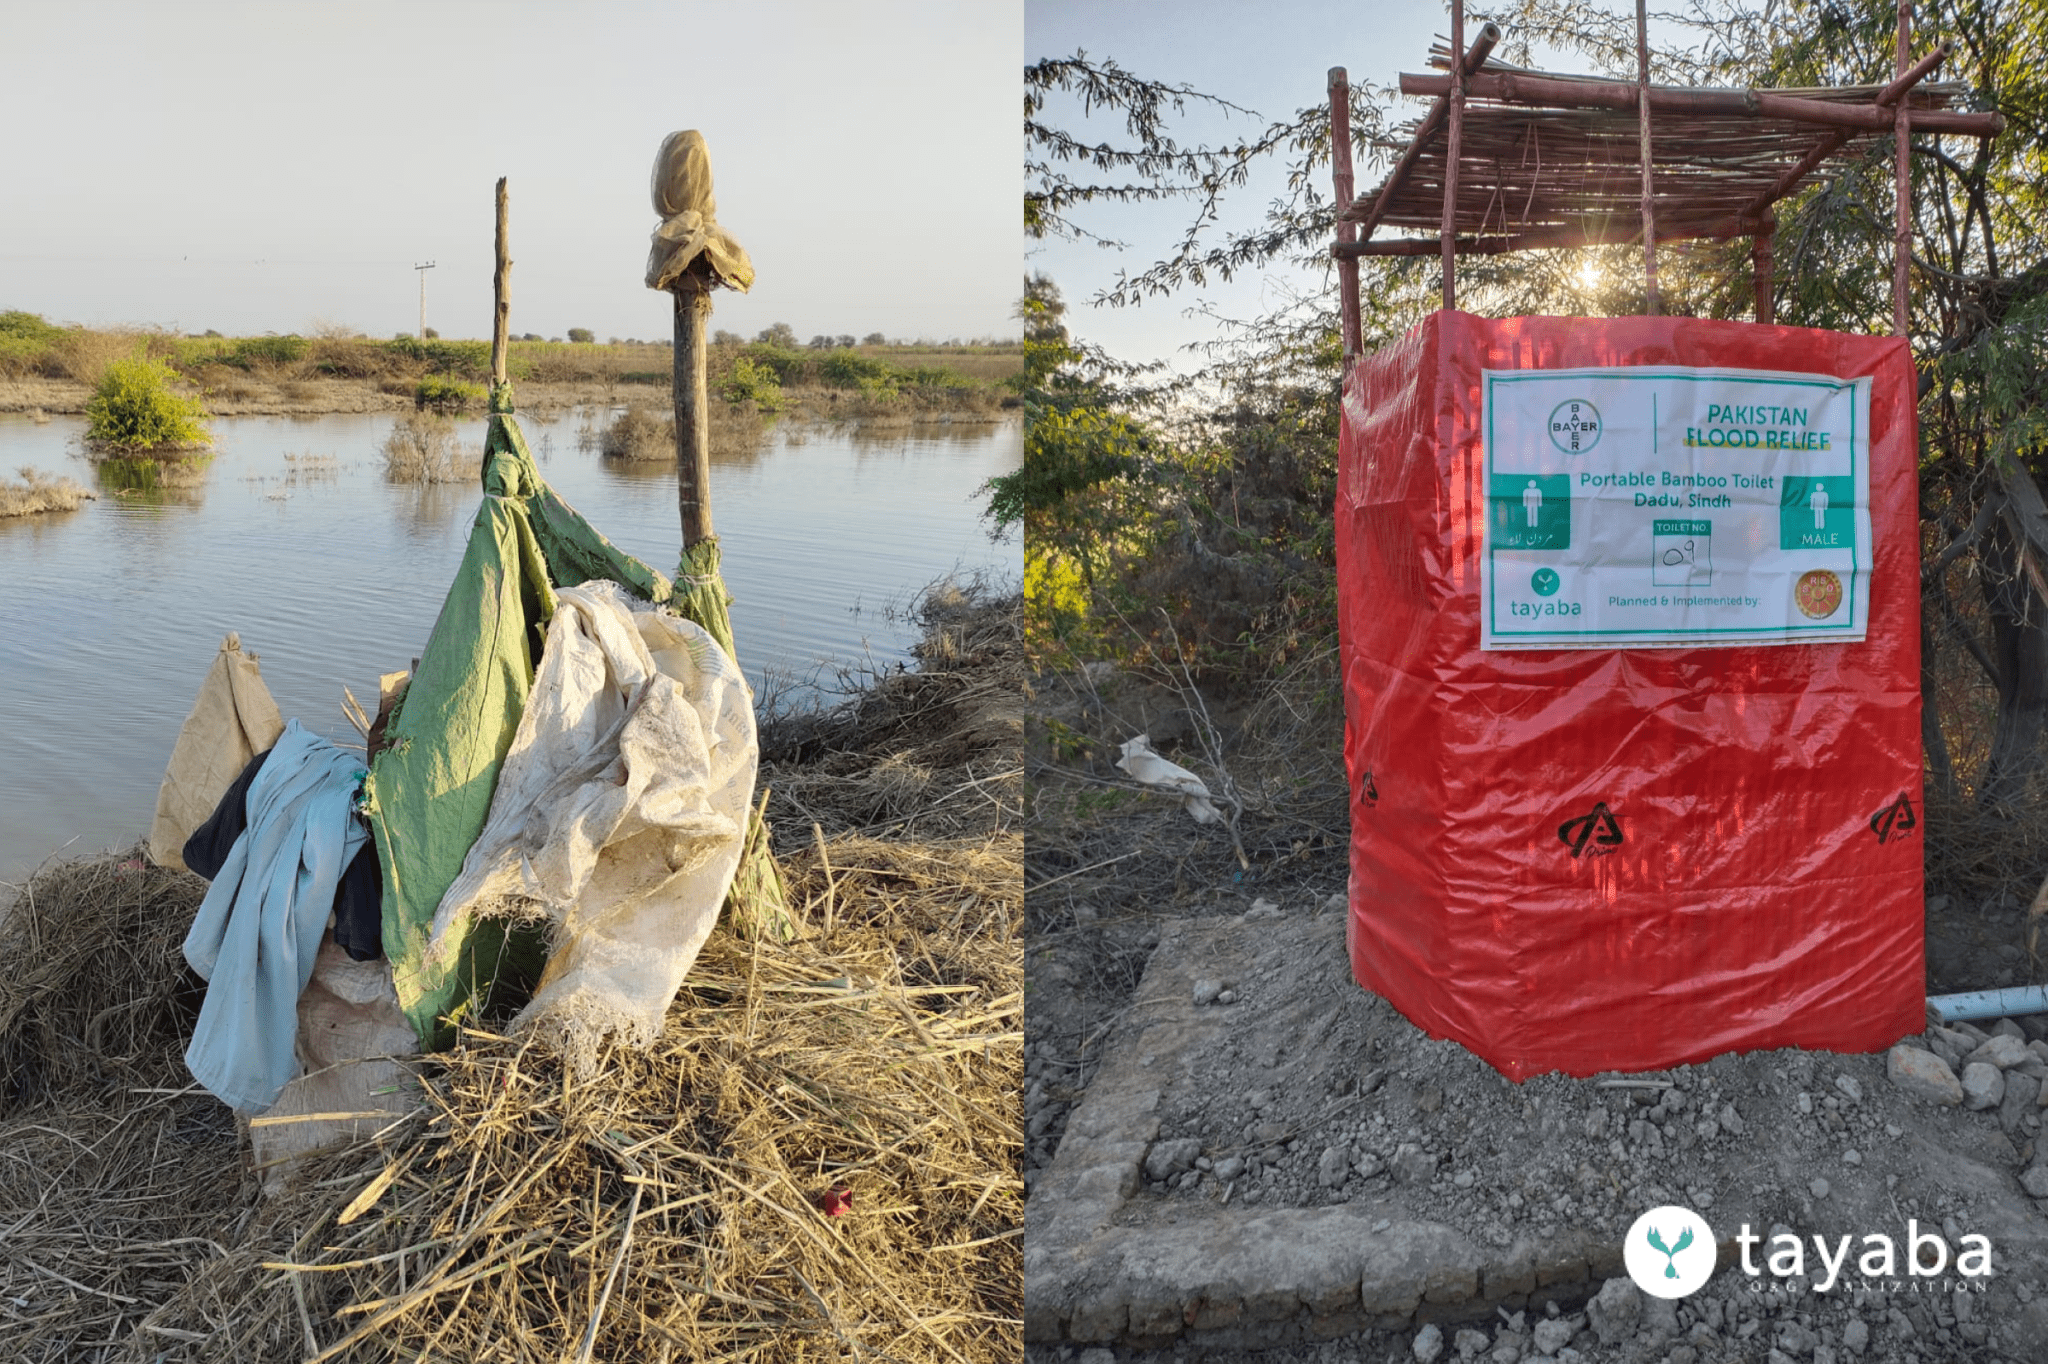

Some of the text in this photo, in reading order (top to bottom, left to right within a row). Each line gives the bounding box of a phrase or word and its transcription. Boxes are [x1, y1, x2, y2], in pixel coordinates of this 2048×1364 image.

[1708, 404, 1807, 426] PAKISTAN
[1553, 422, 1597, 431] BAYER
[1687, 427, 1831, 450] FLOOD RELIEF
[1580, 471, 1774, 489] Portable Bamboo Toilet
[1634, 493, 1732, 508] Dadu, Sindh
[1657, 523, 1690, 532] TOILET
[1802, 533, 1839, 545] MALE
[1609, 596, 1657, 606] Planned
[1661, 596, 1669, 606] &
[1673, 596, 1743, 607] Implemented
[1510, 599, 1582, 620] tayaba
